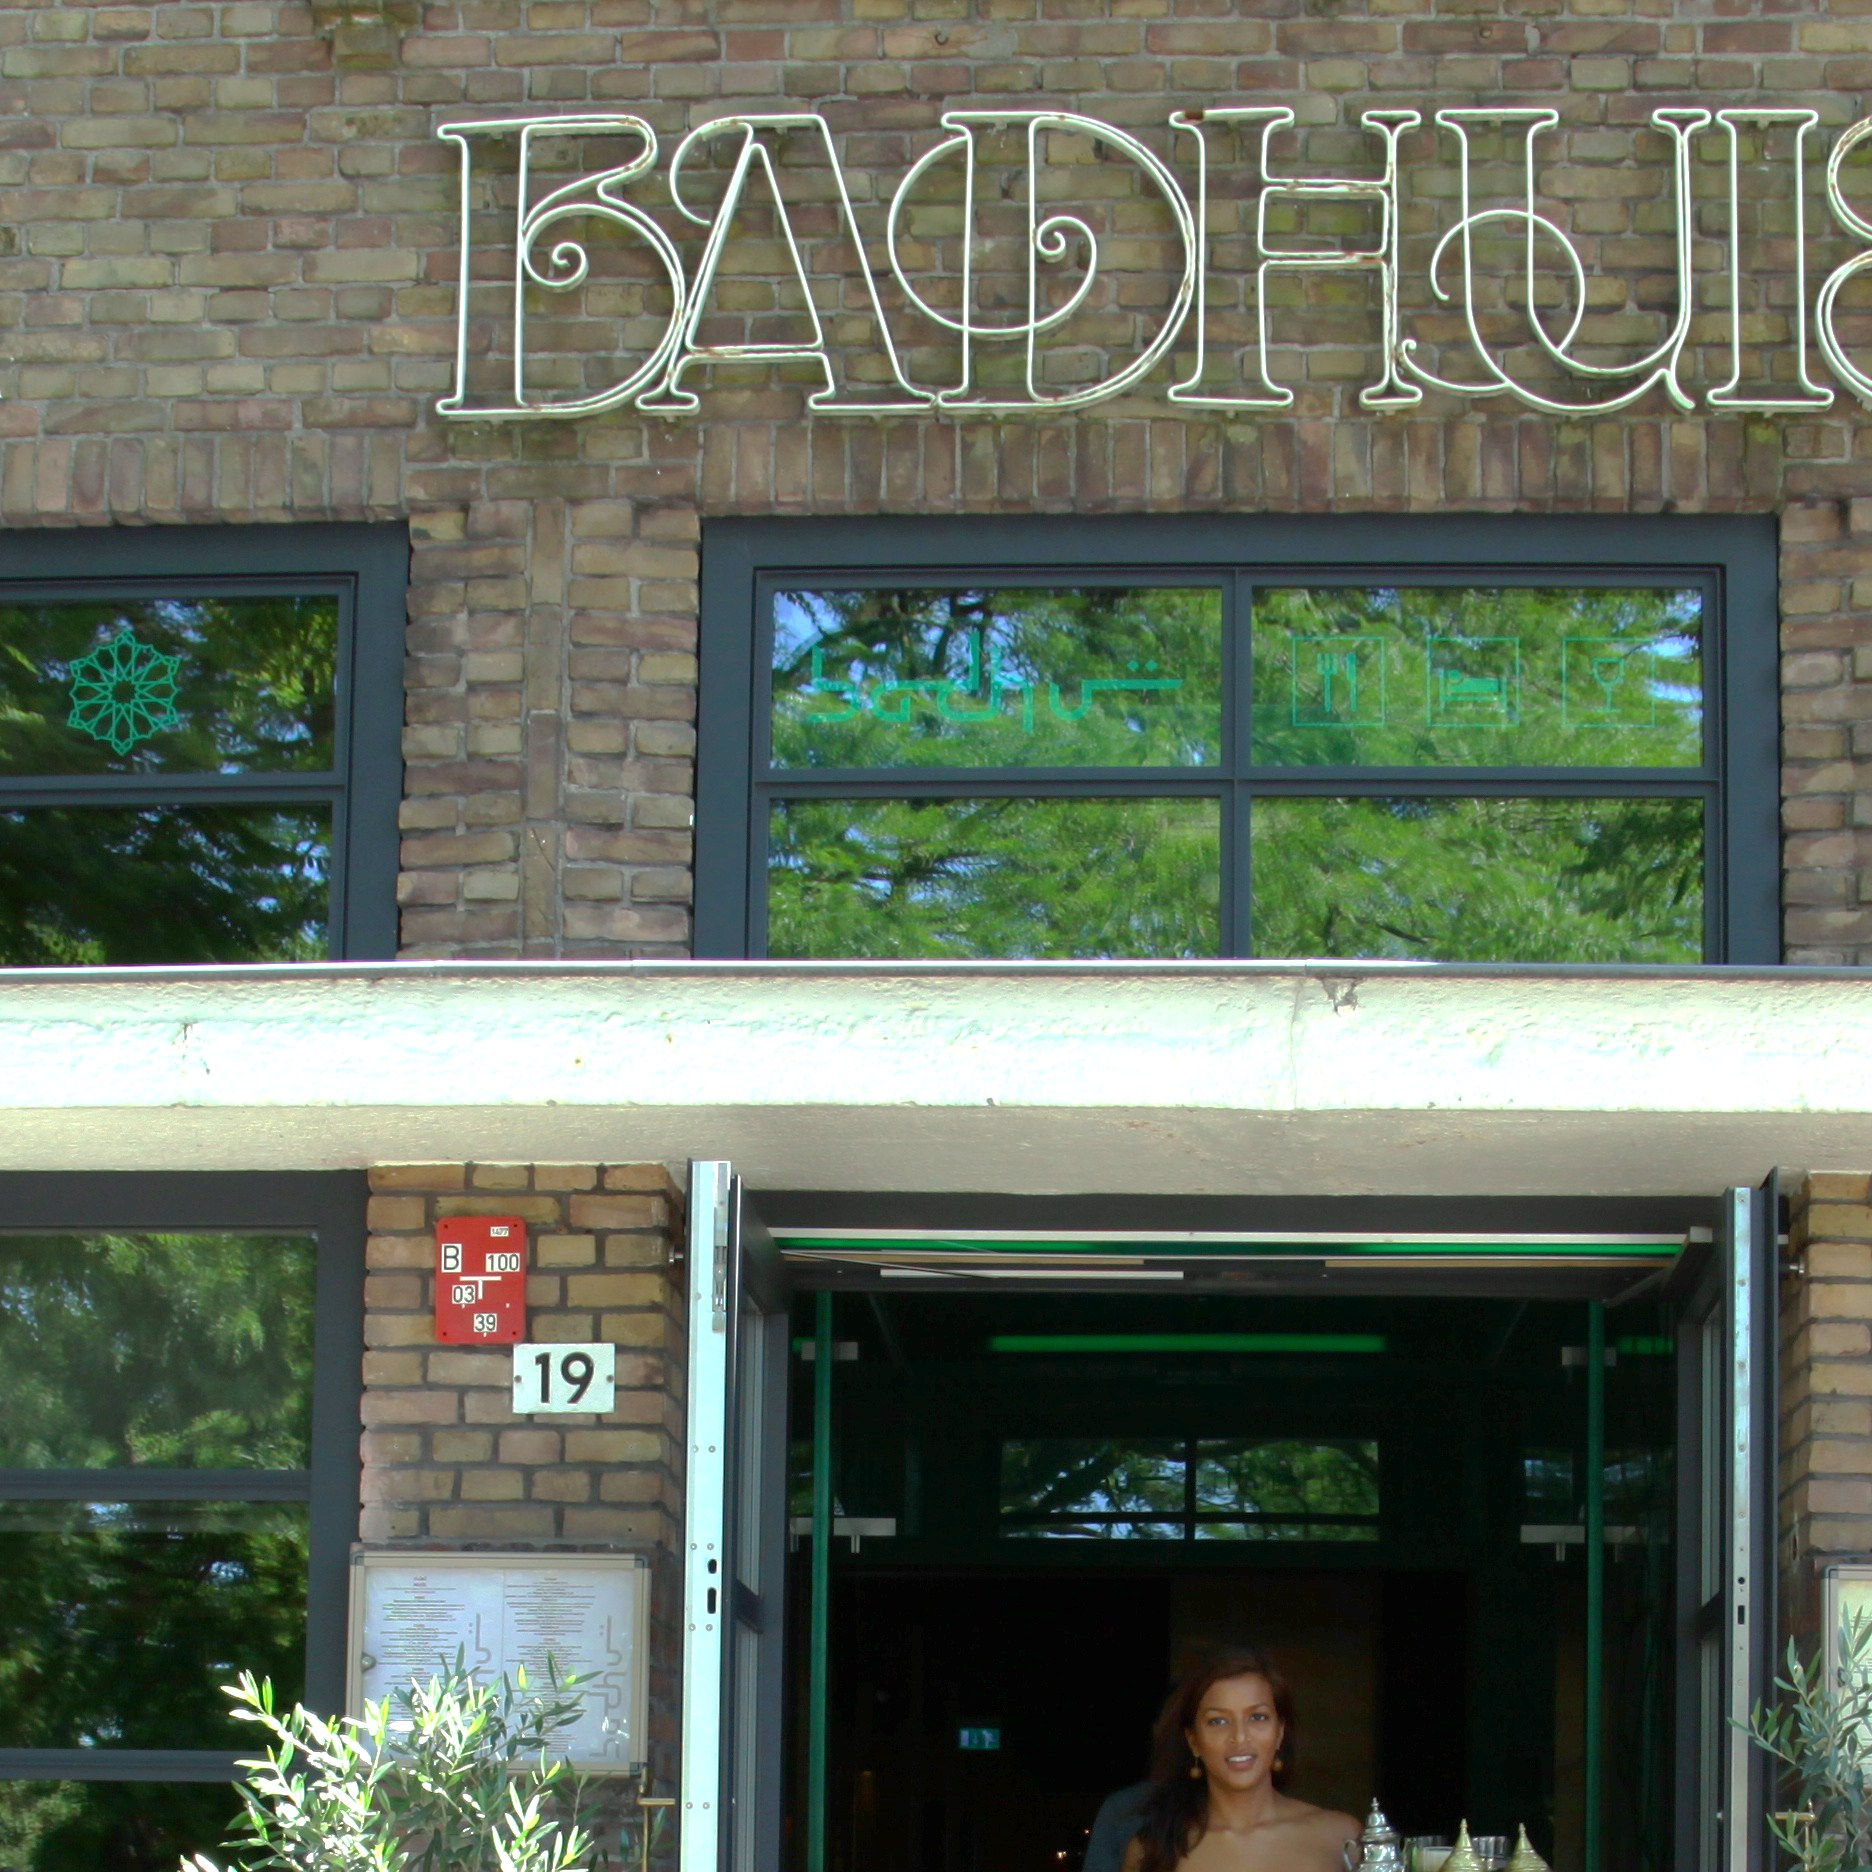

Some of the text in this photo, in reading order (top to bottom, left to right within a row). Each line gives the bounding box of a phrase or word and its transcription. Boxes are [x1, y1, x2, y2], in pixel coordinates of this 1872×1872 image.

[443, 1245, 519, 1272] B 100
[453, 1285, 475, 1303] 03
[474, 1313, 496, 1332] 39
[535, 1351, 595, 1404] 19
